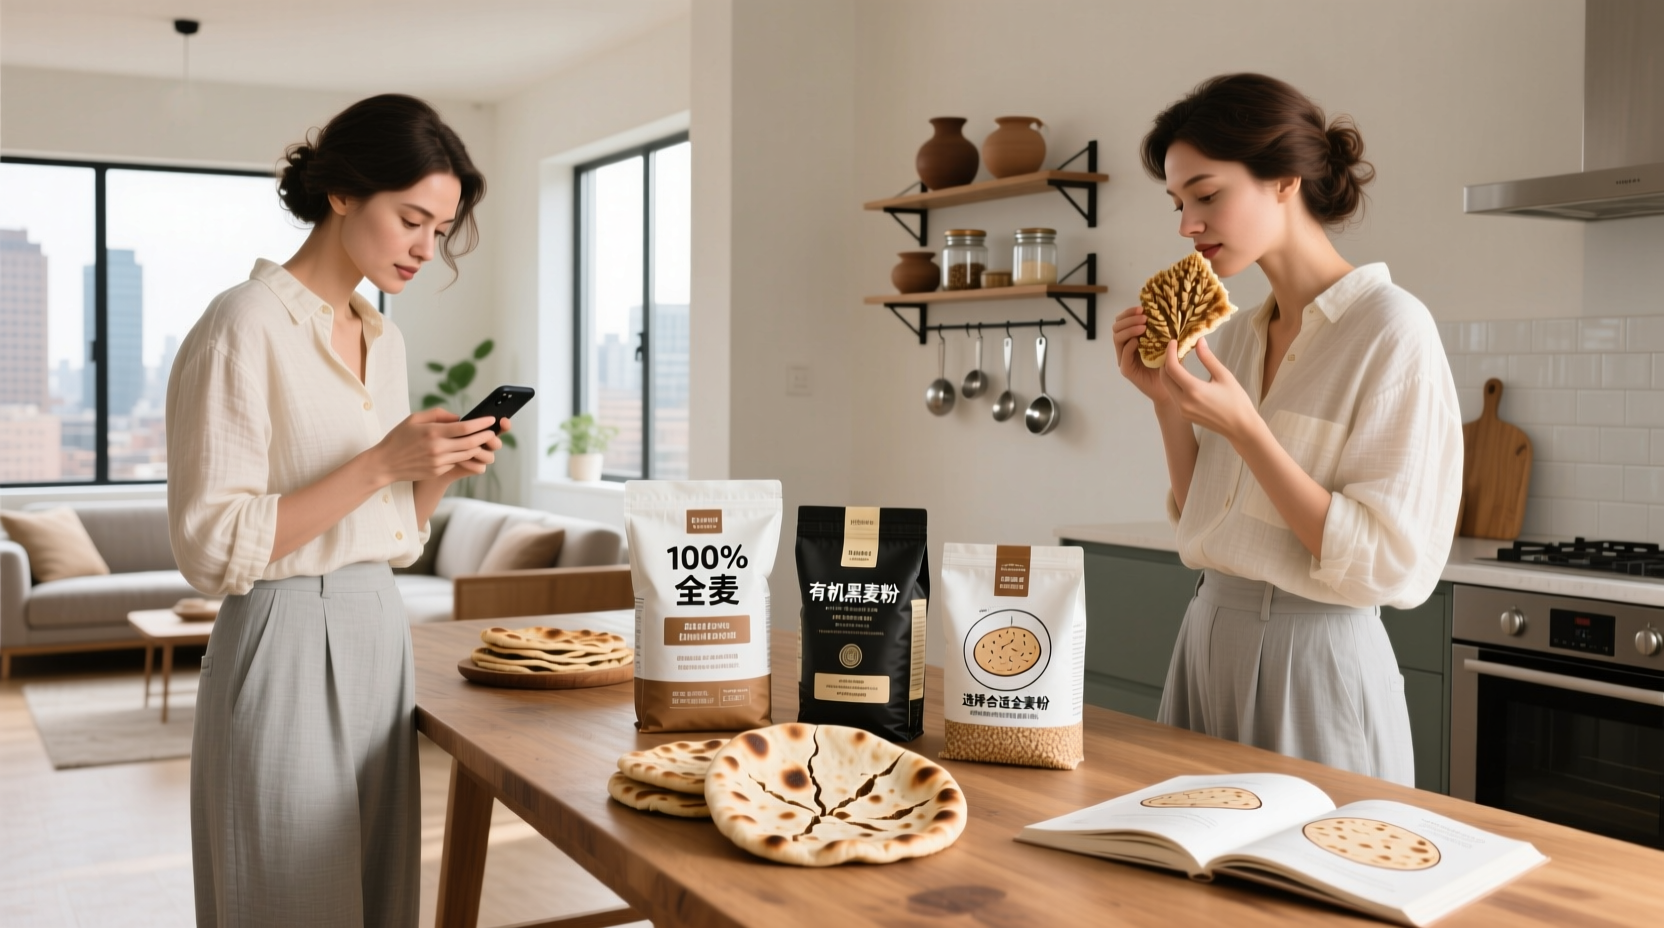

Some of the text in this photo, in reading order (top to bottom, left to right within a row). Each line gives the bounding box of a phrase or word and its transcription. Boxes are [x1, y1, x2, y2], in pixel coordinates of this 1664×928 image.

[667, 544, 748, 570] 100%
[675, 574, 739, 606] 全麦
[809, 581, 900, 604] 有机黑麦粉
